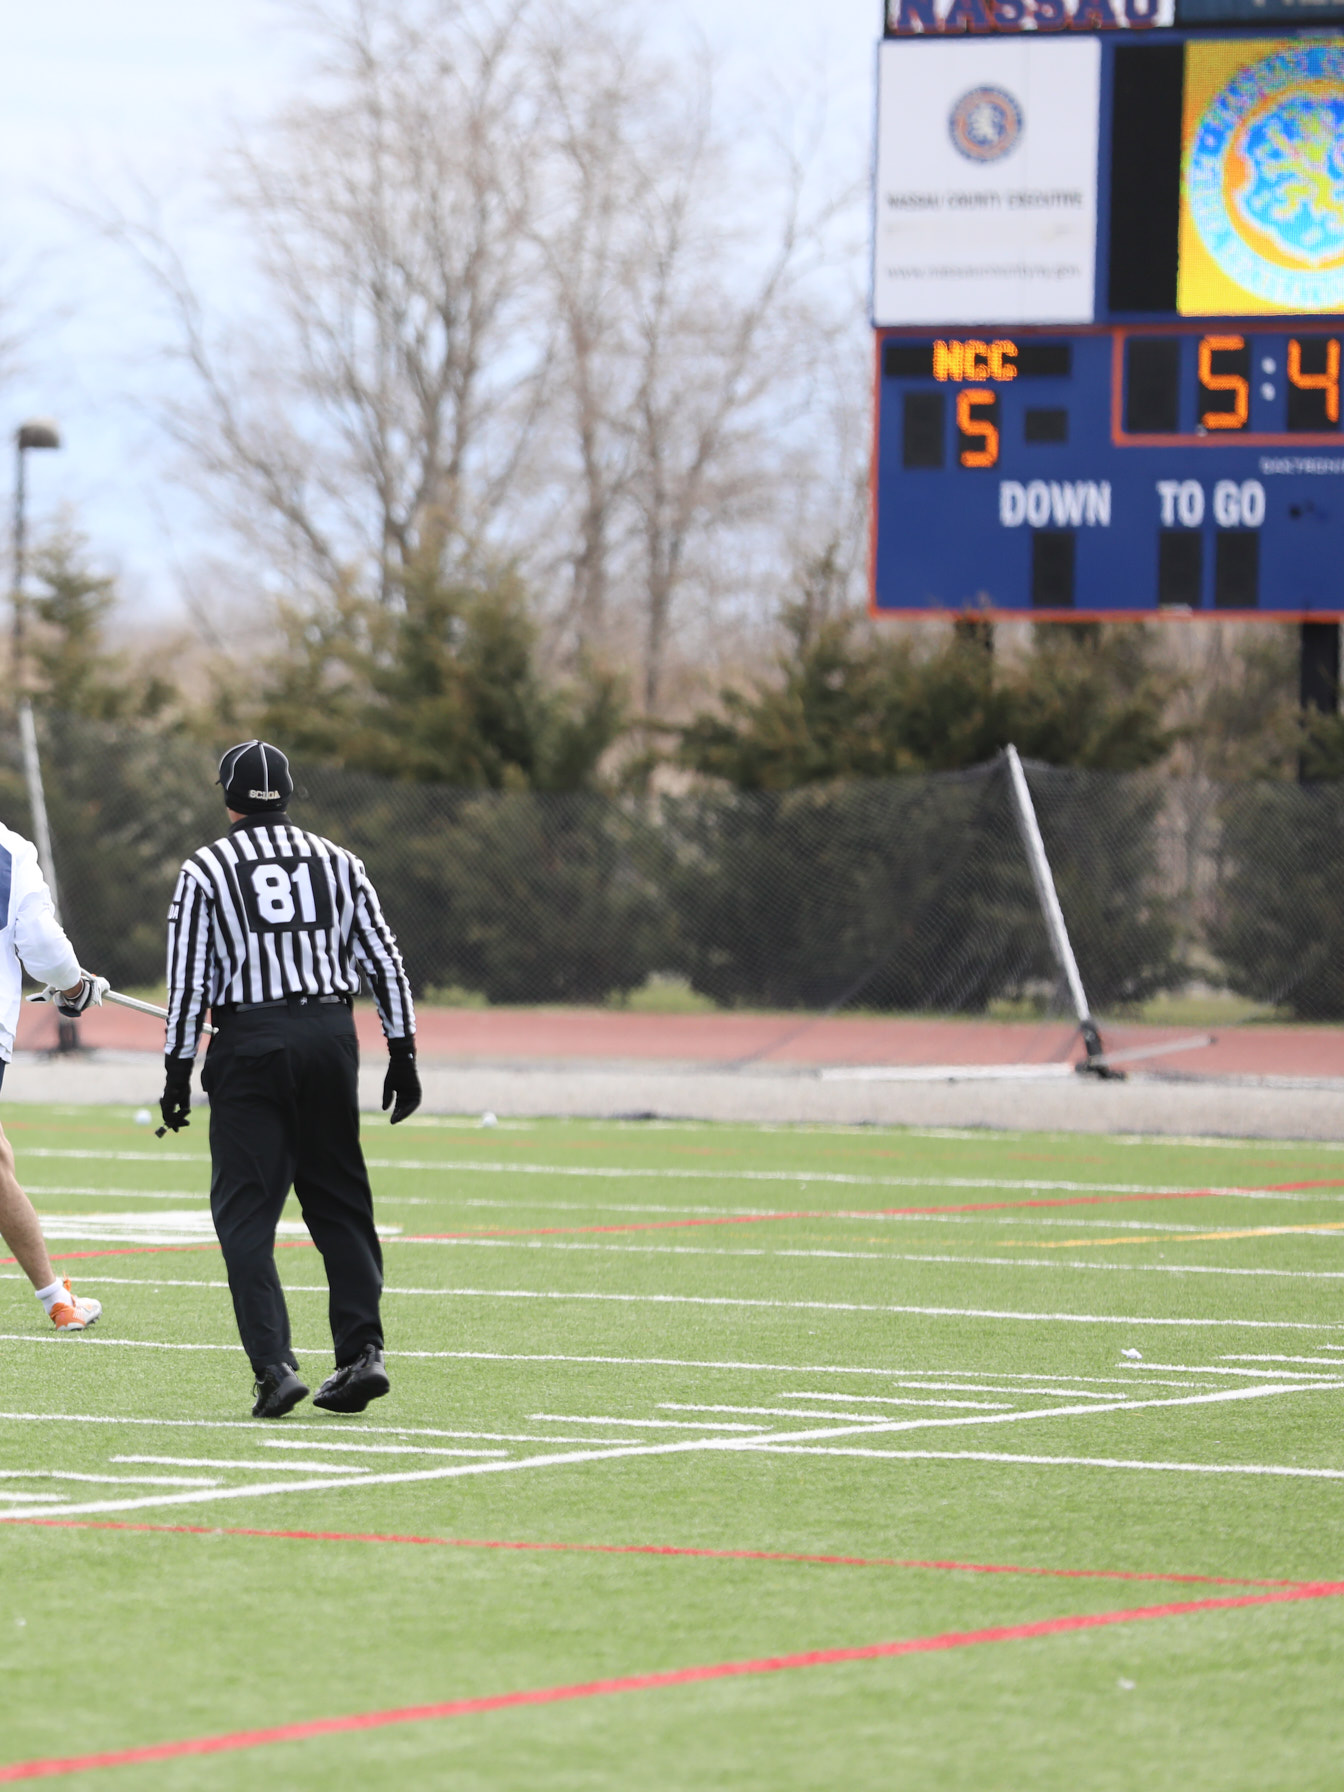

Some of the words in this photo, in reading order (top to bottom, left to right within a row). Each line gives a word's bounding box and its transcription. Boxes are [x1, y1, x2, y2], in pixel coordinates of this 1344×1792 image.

[933, 339, 1018, 381] NCC
[957, 388, 999, 468] 5
[999, 480, 1111, 528] DOWN
[1157, 480, 1205, 528] TO
[1213, 480, 1266, 528] GO
[250, 862, 317, 924] 81
